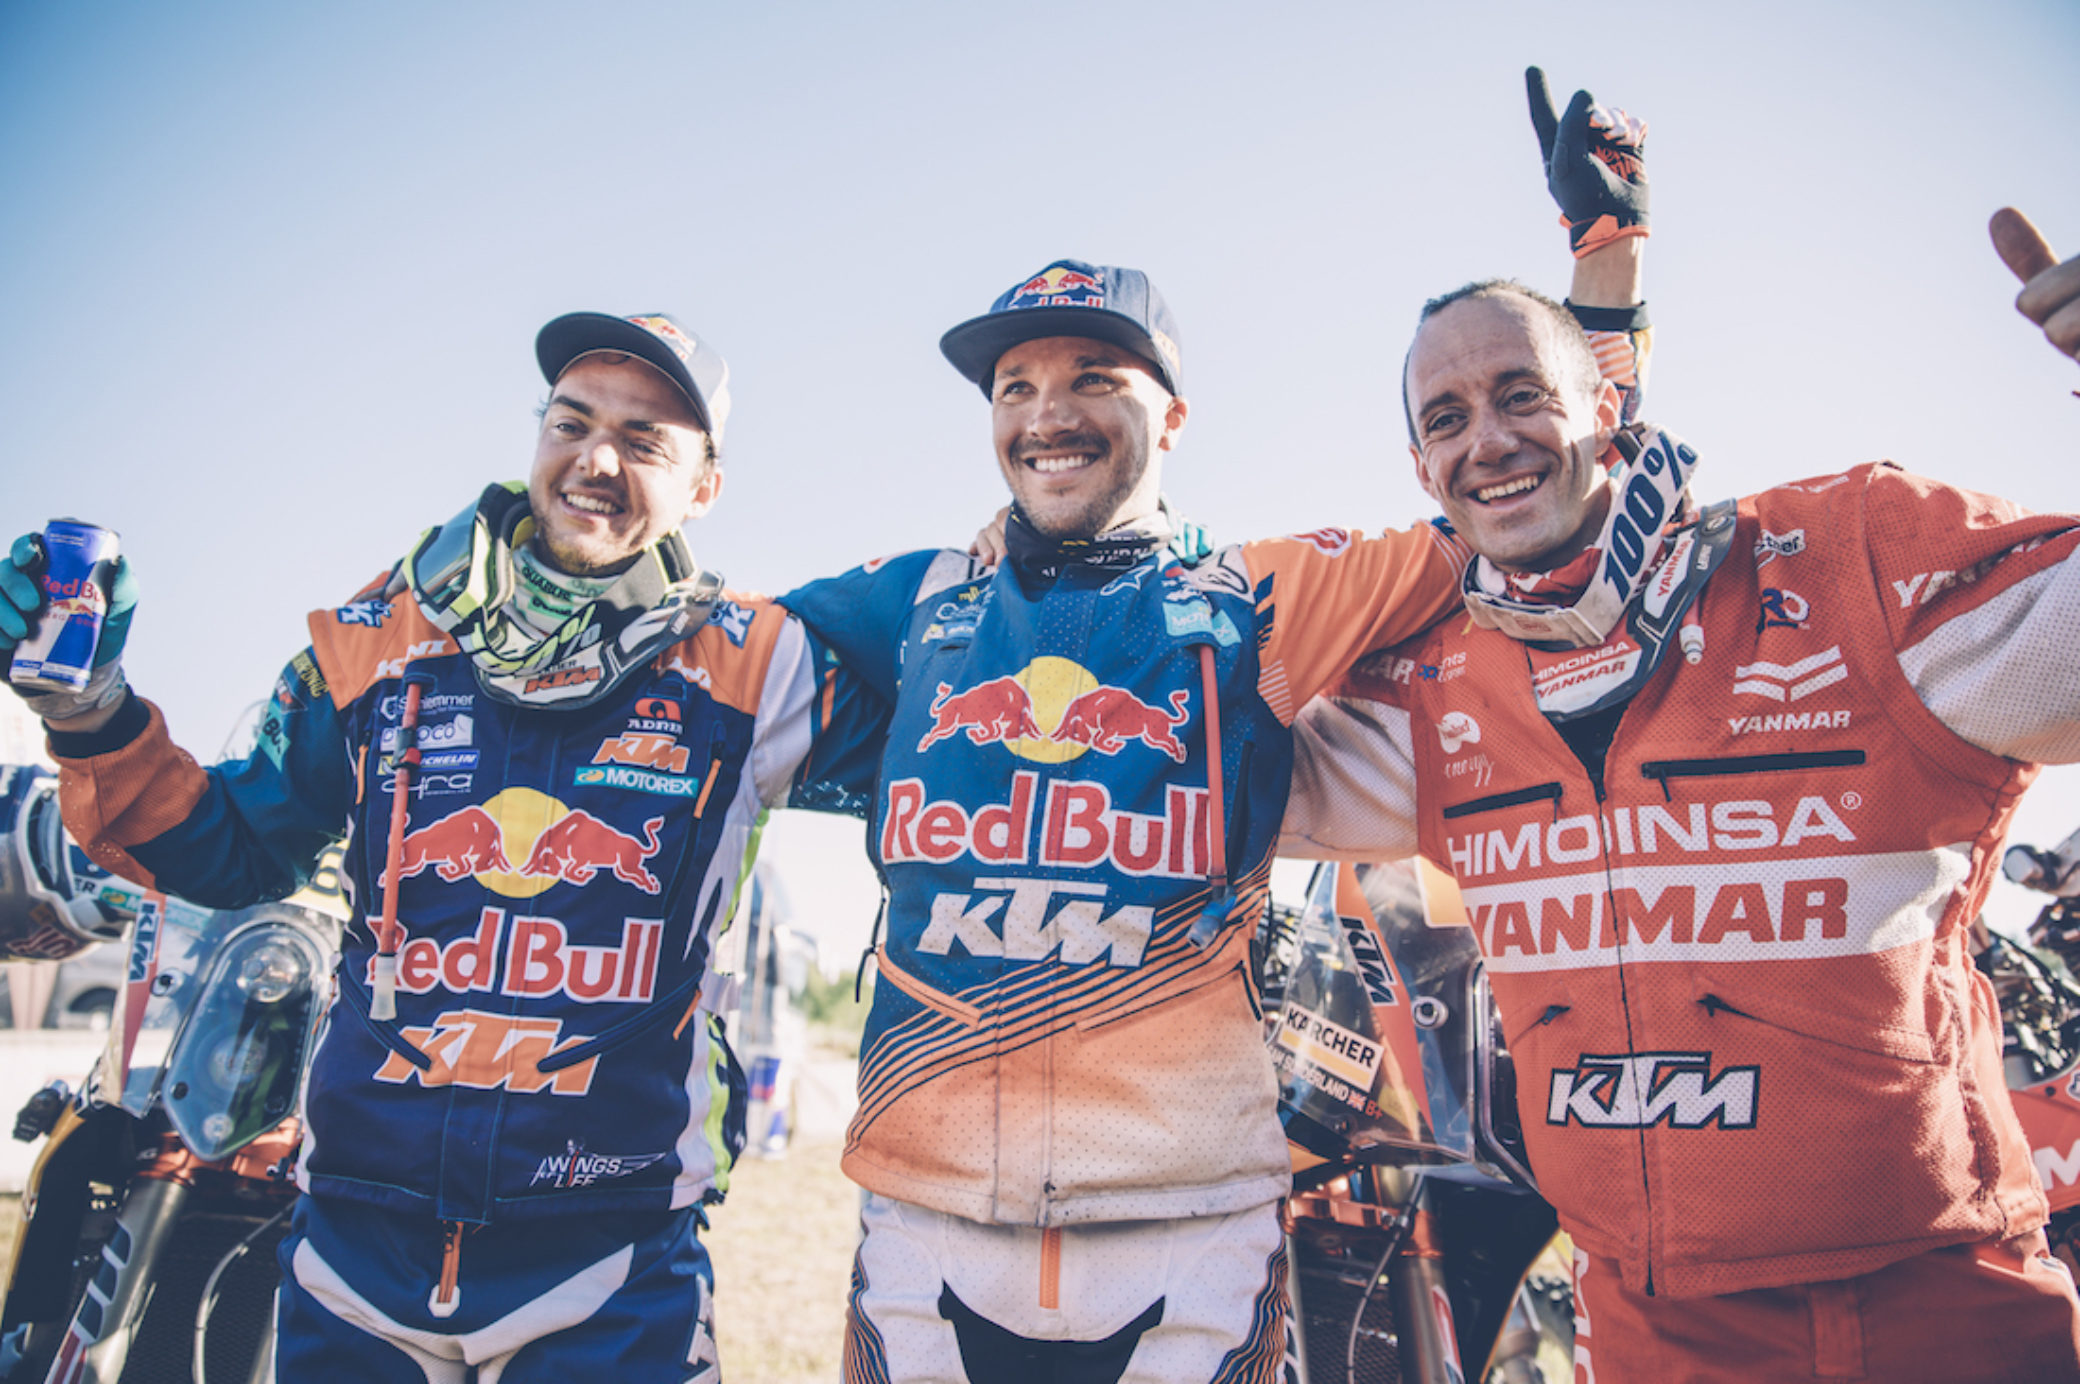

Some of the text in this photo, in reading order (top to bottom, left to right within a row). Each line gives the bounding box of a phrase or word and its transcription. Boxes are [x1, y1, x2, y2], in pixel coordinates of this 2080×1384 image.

[1602, 430, 1699, 604] 100%
[80, 581, 107, 603] Bu
[1657, 539, 1692, 598] YANMAR
[523, 665, 601, 694] KTM
[1536, 659, 1627, 699] YANMAR
[590, 730, 691, 775] KTM
[1727, 710, 1852, 735] YANMAR
[605, 766, 694, 796] MOTOREX
[881, 770, 1211, 881] Red Bull
[1446, 795, 1857, 877] HIMOINSA
[915, 876, 1156, 968] KTM
[1465, 877, 1849, 957] YANMAR
[501, 914, 665, 1004] Bull
[1337, 915, 1399, 1007] KTM
[373, 1009, 600, 1095] KTM
[1546, 1051, 1760, 1130] KTM
[546, 1155, 622, 1174] WINGS
